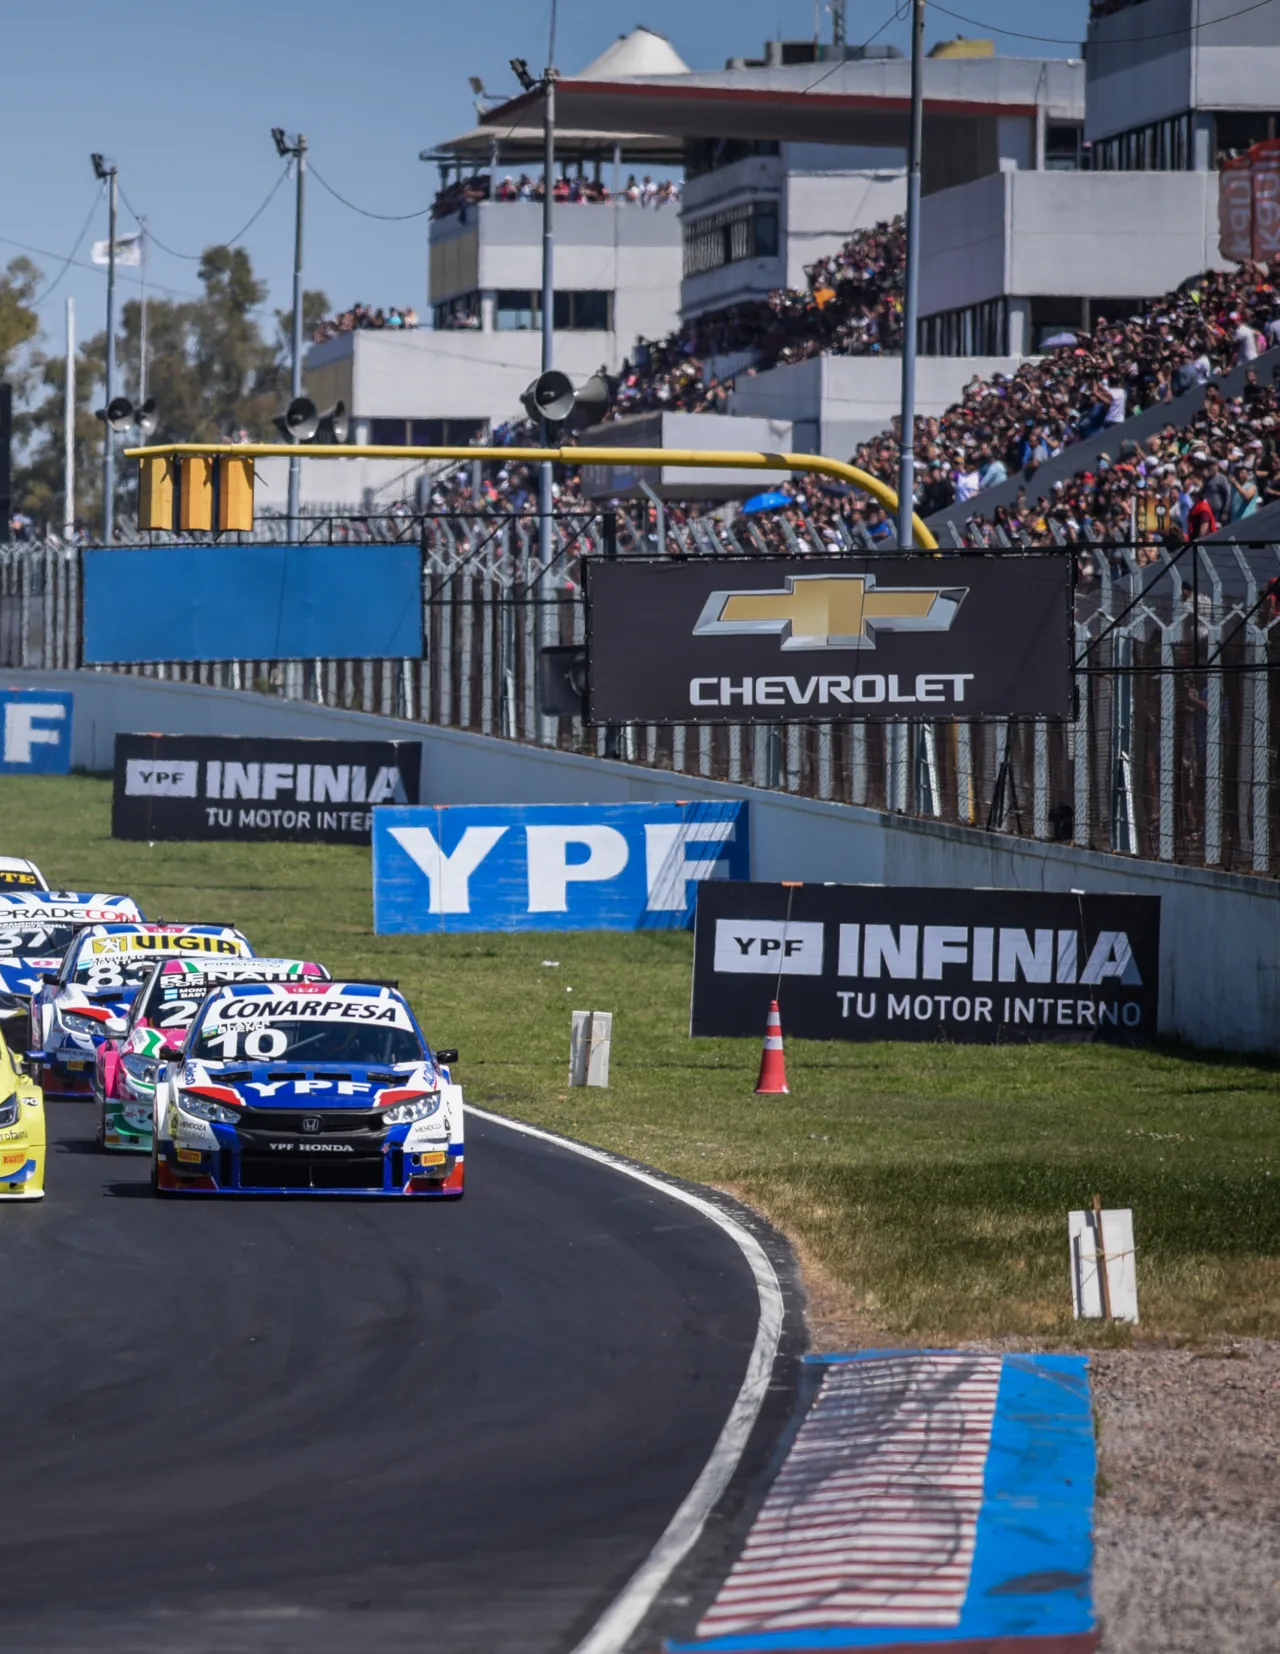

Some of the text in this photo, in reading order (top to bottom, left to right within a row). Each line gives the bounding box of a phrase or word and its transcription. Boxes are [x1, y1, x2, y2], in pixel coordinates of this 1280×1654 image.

[690, 673, 974, 706] CHEVROLET
[139, 771, 185, 785] YPF
[205, 760, 408, 803] INFINIA
[206, 807, 232, 828] TU
[239, 808, 310, 829] MOTOR
[388, 822, 737, 914] YPF
[732, 936, 804, 957] YPF
[837, 923, 1143, 986] INFINIA
[220, 999, 396, 1022] CONARPESA
[836, 991, 1141, 1027] TU MOTOR INTERNO
[207, 1028, 288, 1059] 10
[246, 1080, 373, 1097] YPF
[299, 1143, 354, 1152] HONDA
